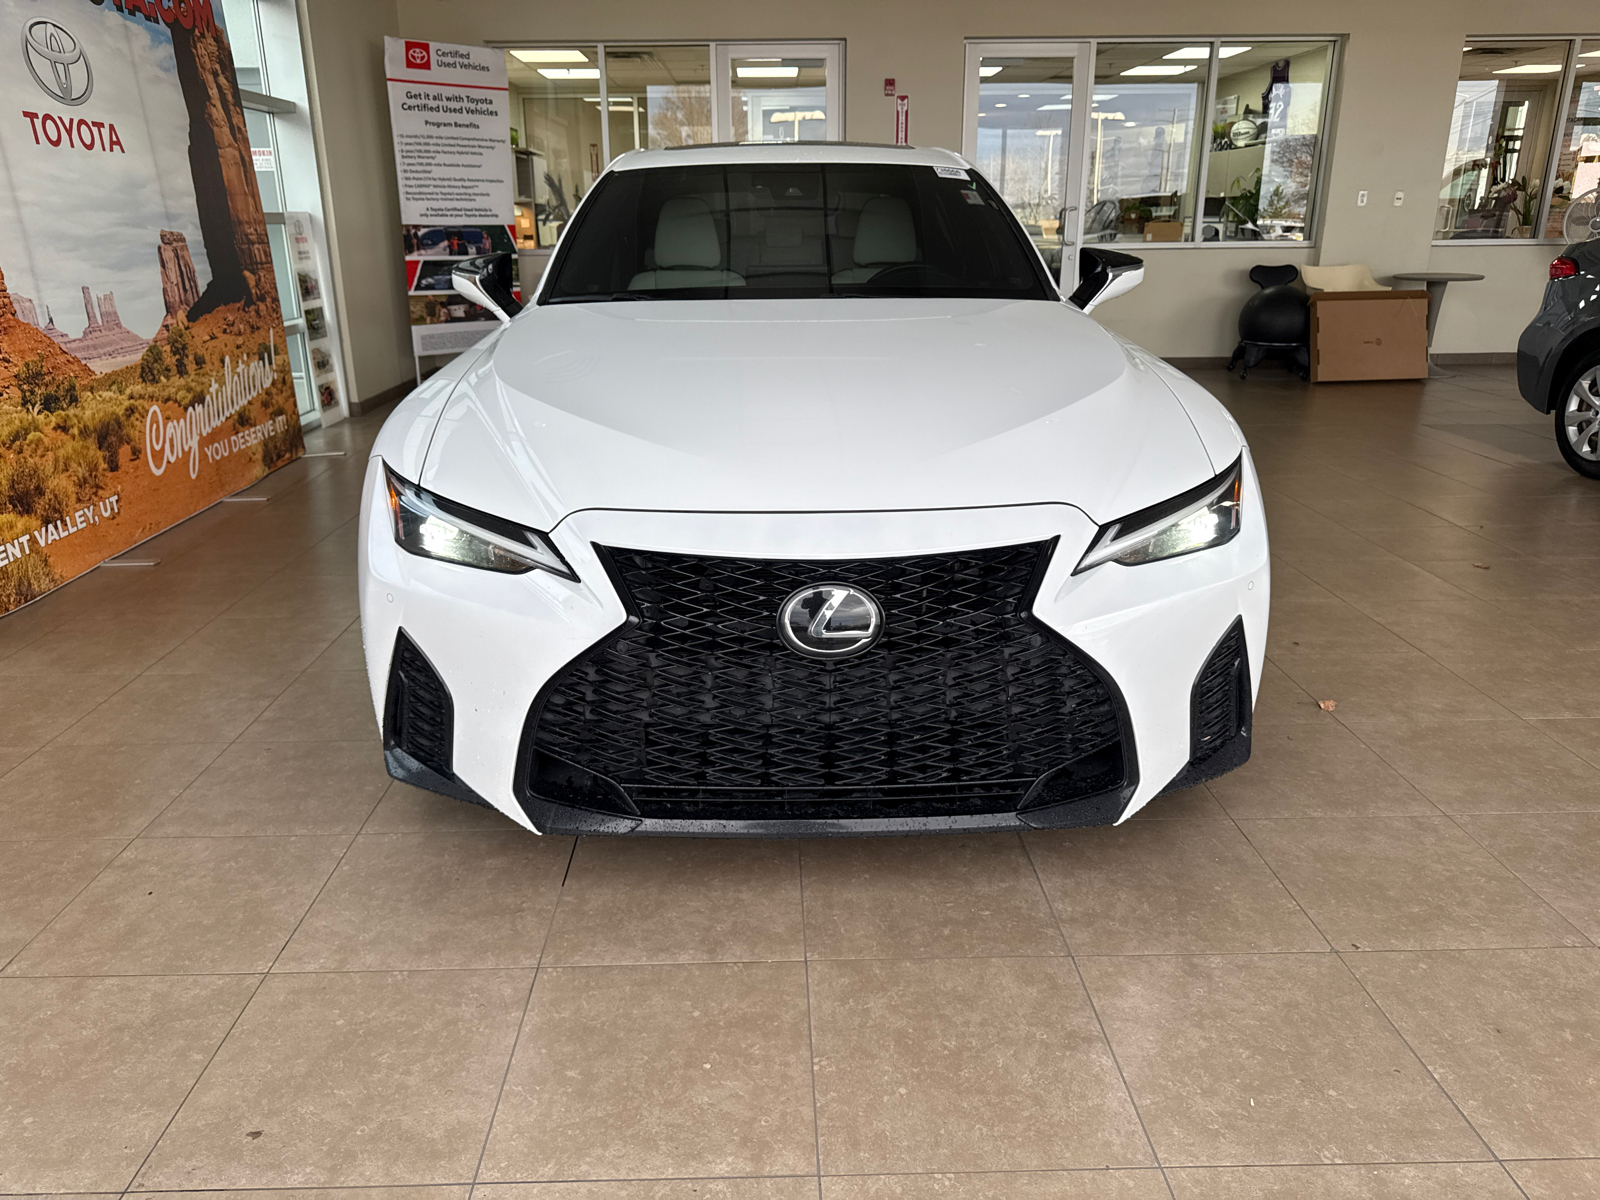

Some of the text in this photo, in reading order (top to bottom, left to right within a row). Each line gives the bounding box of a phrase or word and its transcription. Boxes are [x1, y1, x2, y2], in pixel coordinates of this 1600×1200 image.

[436, 49, 470, 60] Certified
[436, 59, 490, 72] Used Vehicles
[406, 91, 493, 106] Get it all with Toyota
[402, 102, 498, 116] Certified Used Vehicles
[22, 110, 125, 153] TOYOTA
[425, 120, 480, 129] Program Benefits
[146, 327, 277, 479] Congratulations!
[204, 414, 288, 463] YOU DESERVE IT!
[33, 505, 99, 548] VALLEY,
[100, 495, 119, 517] UT
